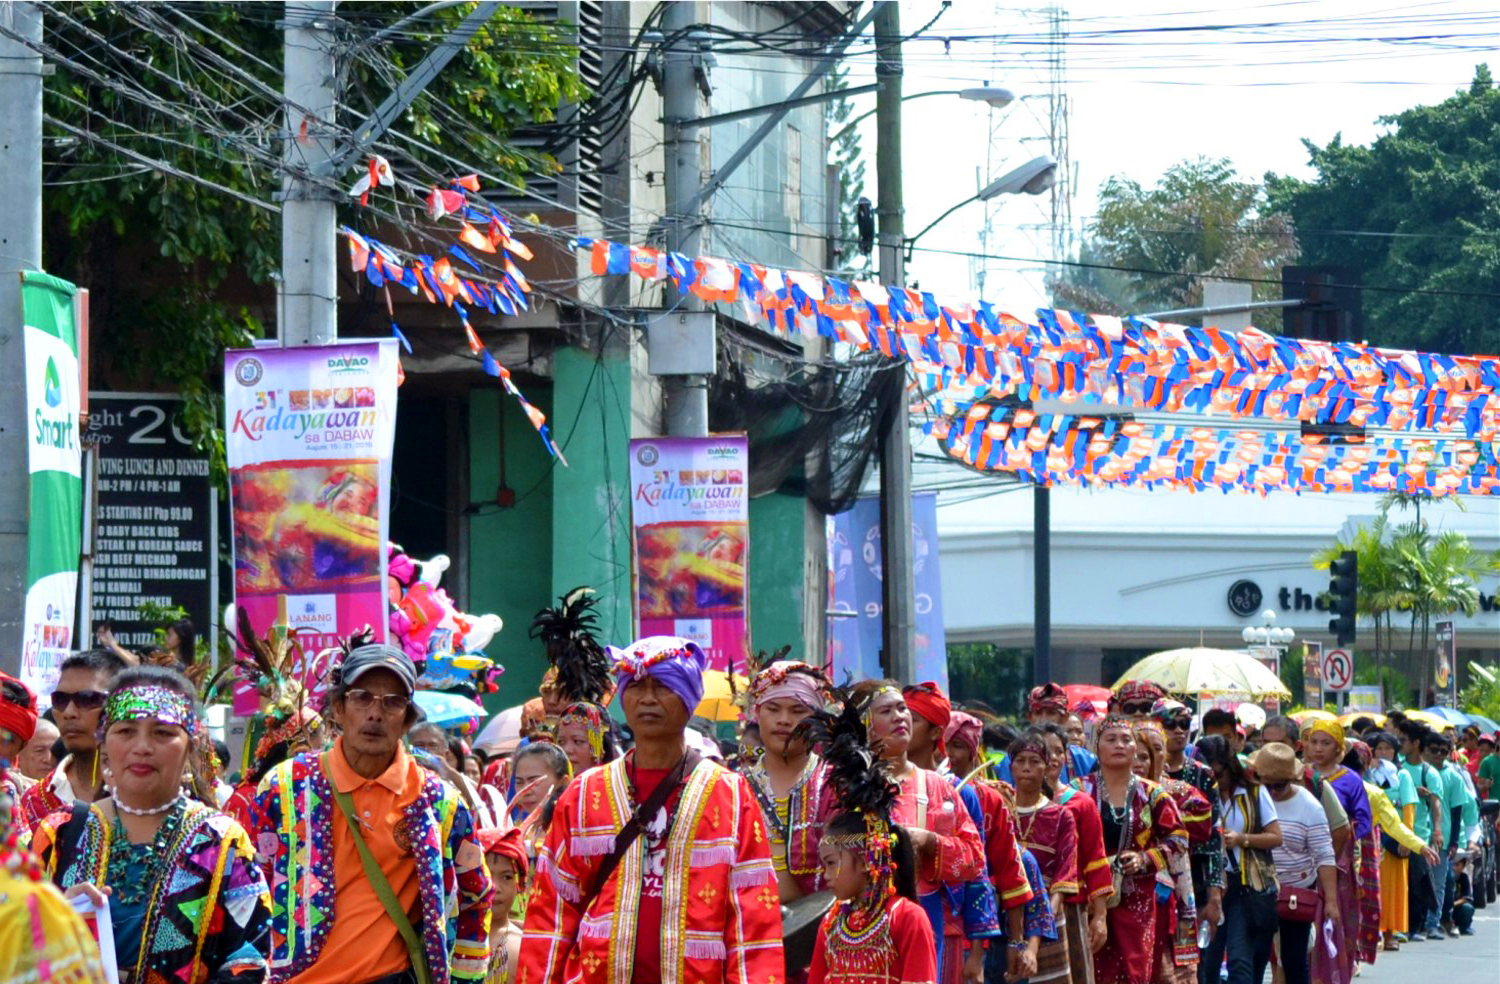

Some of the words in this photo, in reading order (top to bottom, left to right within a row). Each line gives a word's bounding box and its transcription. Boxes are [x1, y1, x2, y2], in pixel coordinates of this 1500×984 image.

[327, 354, 369, 368] DAVAO
[88, 409, 123, 430] ght
[232, 407, 377, 441] Kadayawan
[35, 408, 74, 450] Smart
[324, 430, 374, 442] DABAW
[125, 458, 155, 475] LUNCH
[156, 458, 175, 475] AND
[176, 459, 209, 476] DINNER
[635, 481, 744, 507] Kadayawan
[106, 506, 142, 520] STARTING
[143, 506, 153, 520] AT
[138, 541, 173, 552] KOREAN
[174, 541, 203, 553] SAUCE
[107, 568, 142, 580] KAWALI
[107, 582, 142, 594] KAWALI
[106, 596, 132, 607] FRIED
[290, 613, 333, 623] LANANG
